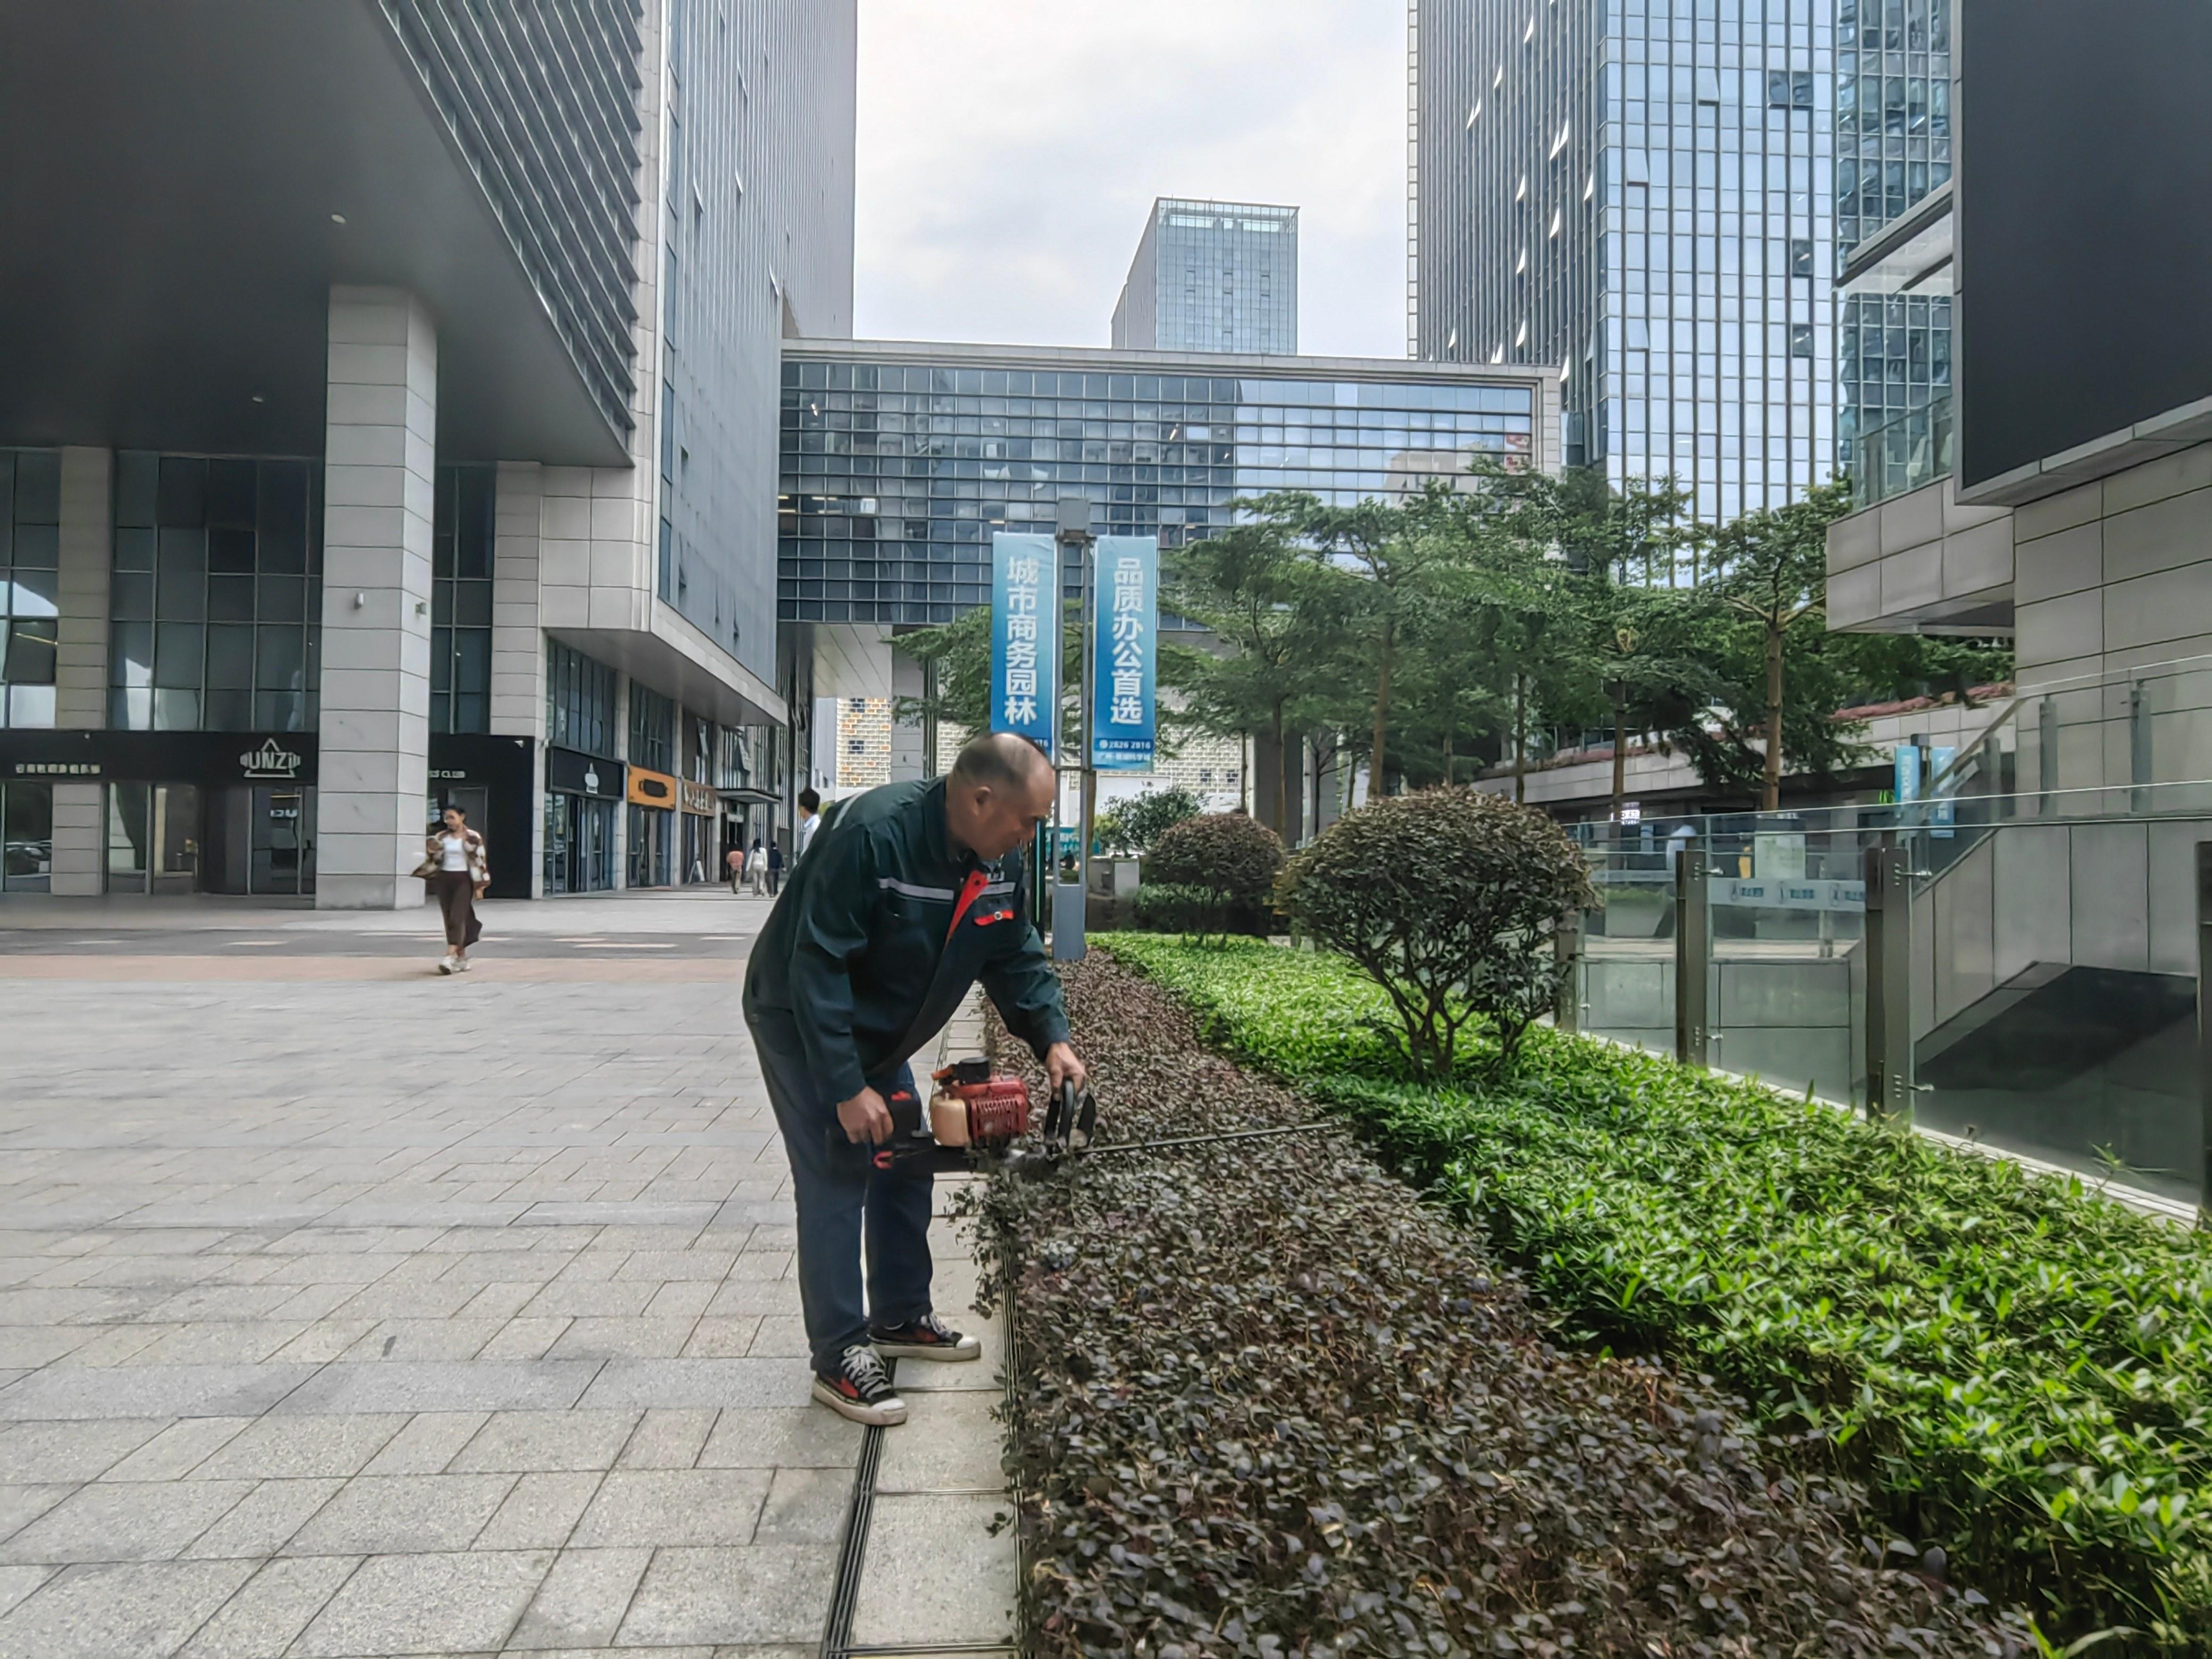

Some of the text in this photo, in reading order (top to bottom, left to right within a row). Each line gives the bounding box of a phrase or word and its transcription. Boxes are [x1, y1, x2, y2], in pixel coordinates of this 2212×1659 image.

[1004, 556, 1039, 726] 城市商务园林
[1110, 558, 1144, 725] 品质办公首选
